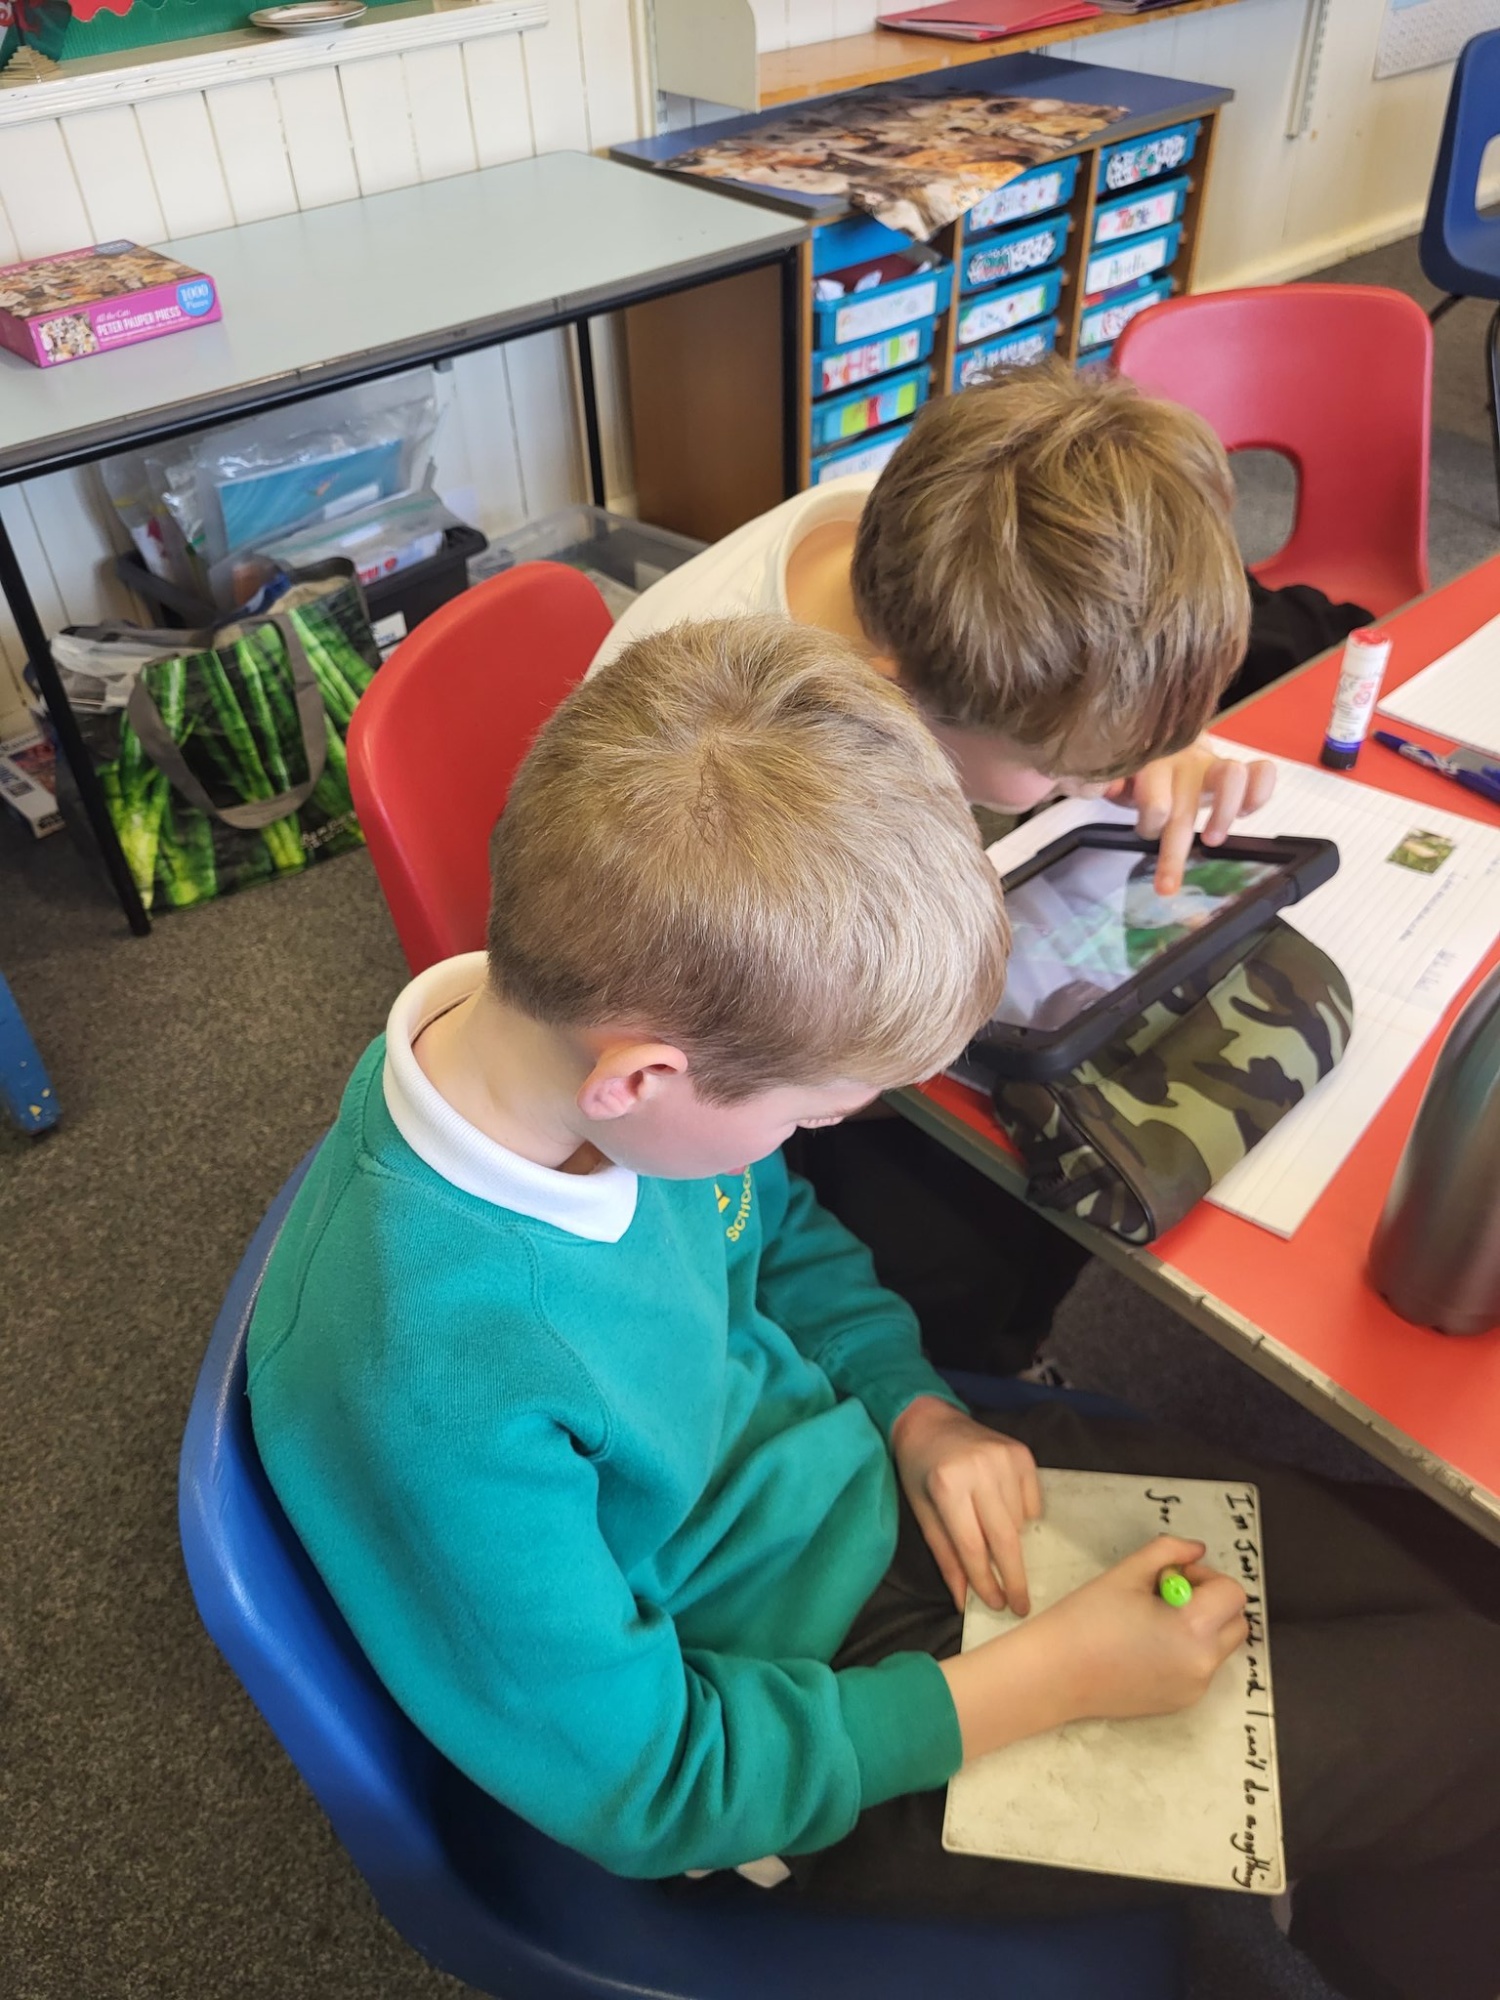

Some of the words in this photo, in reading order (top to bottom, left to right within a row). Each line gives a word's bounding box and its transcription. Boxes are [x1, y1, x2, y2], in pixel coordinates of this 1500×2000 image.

[180, 284, 209, 302] 1000
[97, 320, 123, 337] PETER
[123, 312, 155, 331] PAUPER
[155, 305, 181, 320] PRESS
[1247, 1655, 1267, 1697] and
[1243, 1778, 1270, 1805] do
